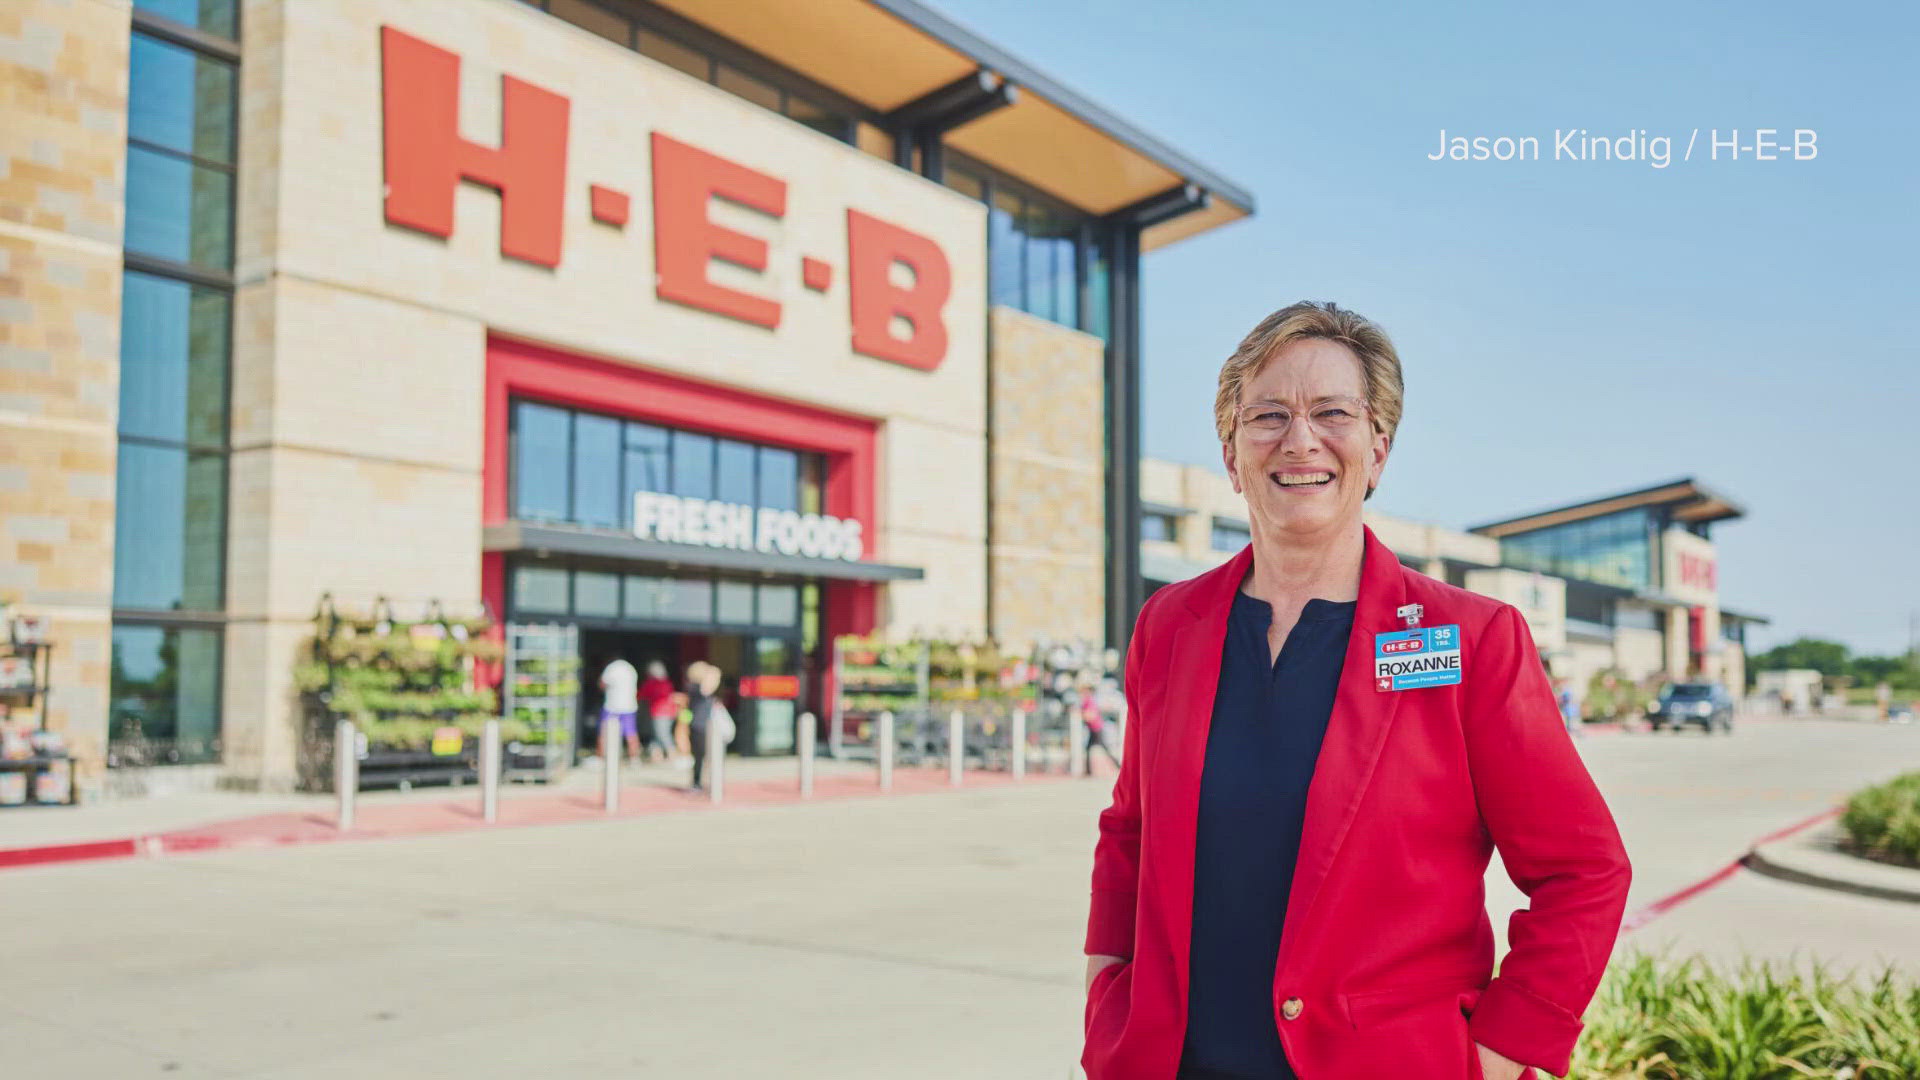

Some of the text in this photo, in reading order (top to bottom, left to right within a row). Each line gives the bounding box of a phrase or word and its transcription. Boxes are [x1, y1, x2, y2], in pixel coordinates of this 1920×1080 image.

[633, 490, 864, 562] FRESH FOODS
[1435, 629, 1451, 640] 35
[1379, 656, 1459, 676] ROXANNE
